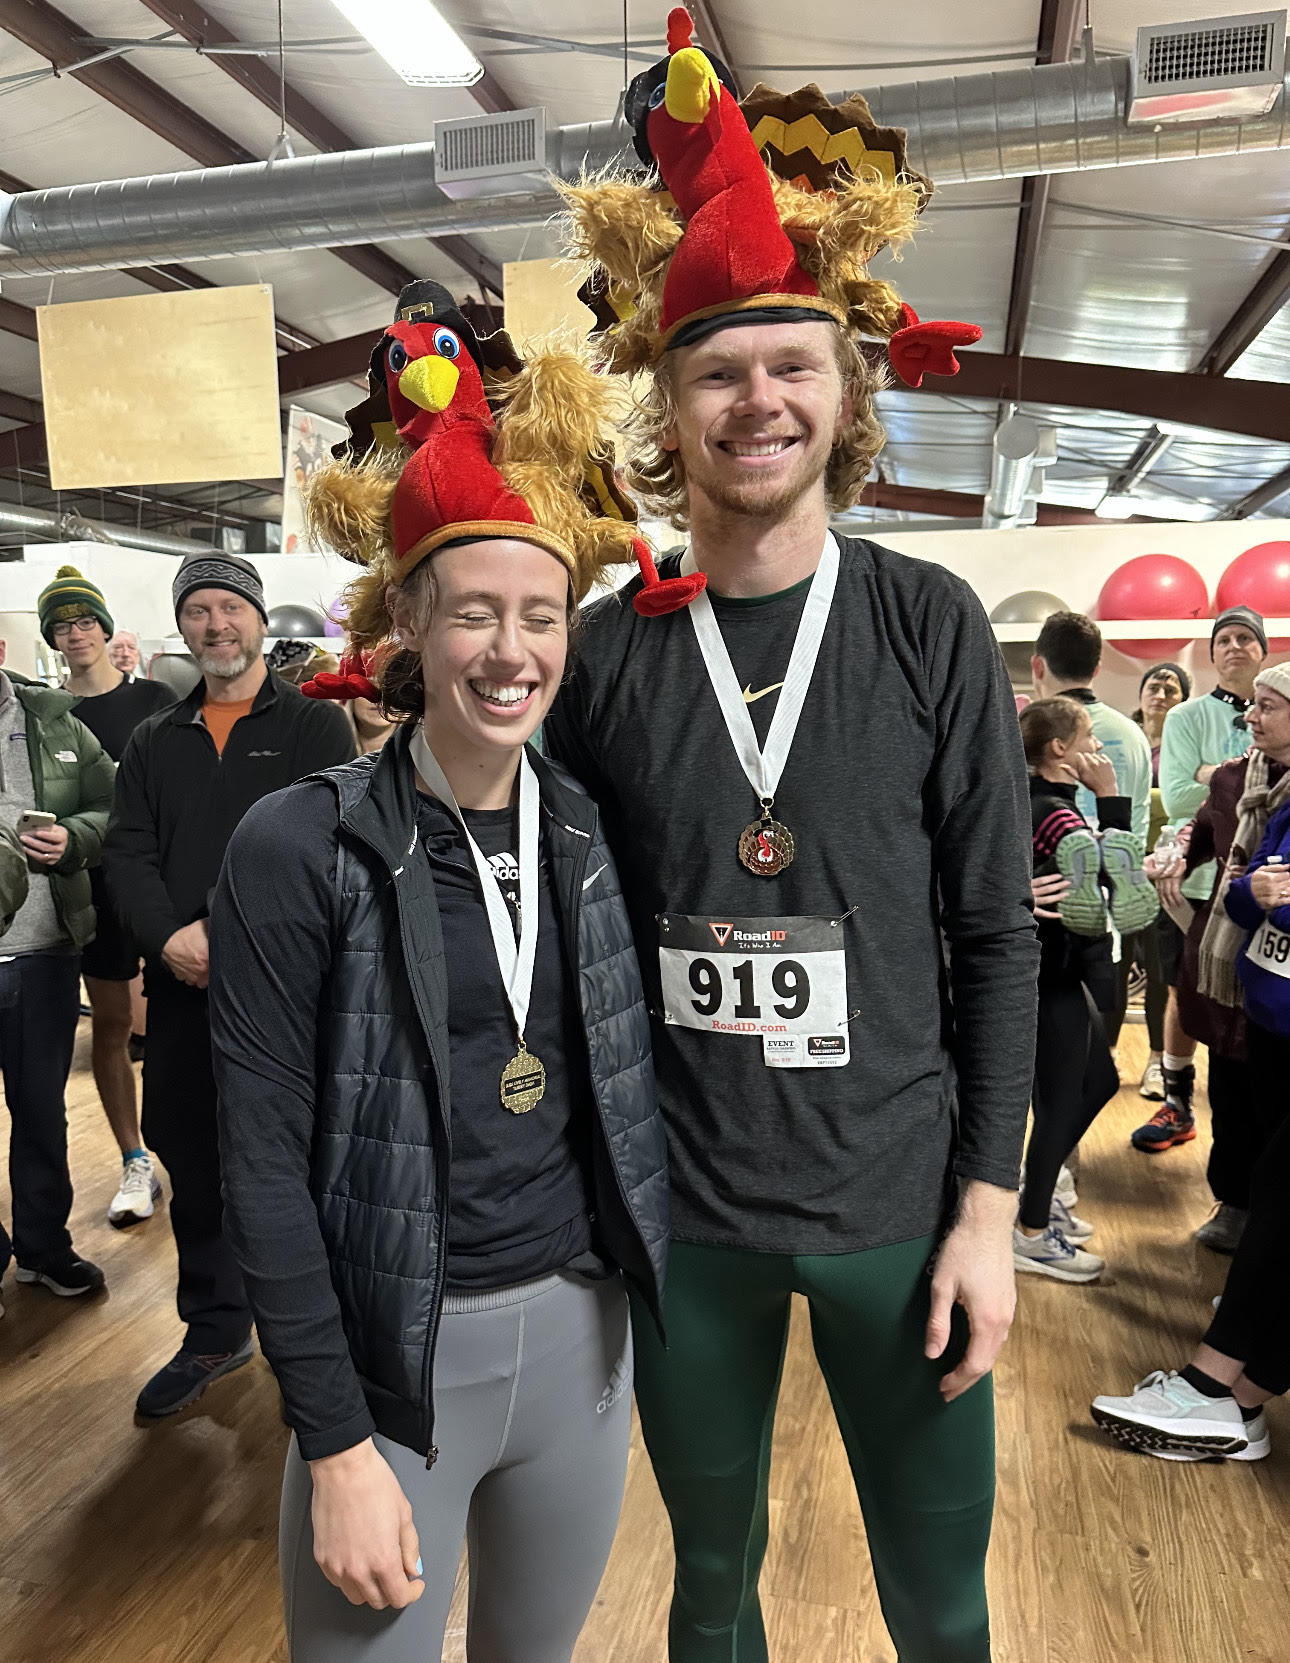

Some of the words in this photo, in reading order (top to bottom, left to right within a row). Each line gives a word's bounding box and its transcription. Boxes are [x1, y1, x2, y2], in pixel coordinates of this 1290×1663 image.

[733, 930, 786, 941] RoadID
[688, 957, 811, 1020] 919
[712, 1020, 787, 1032] RoadID.com
